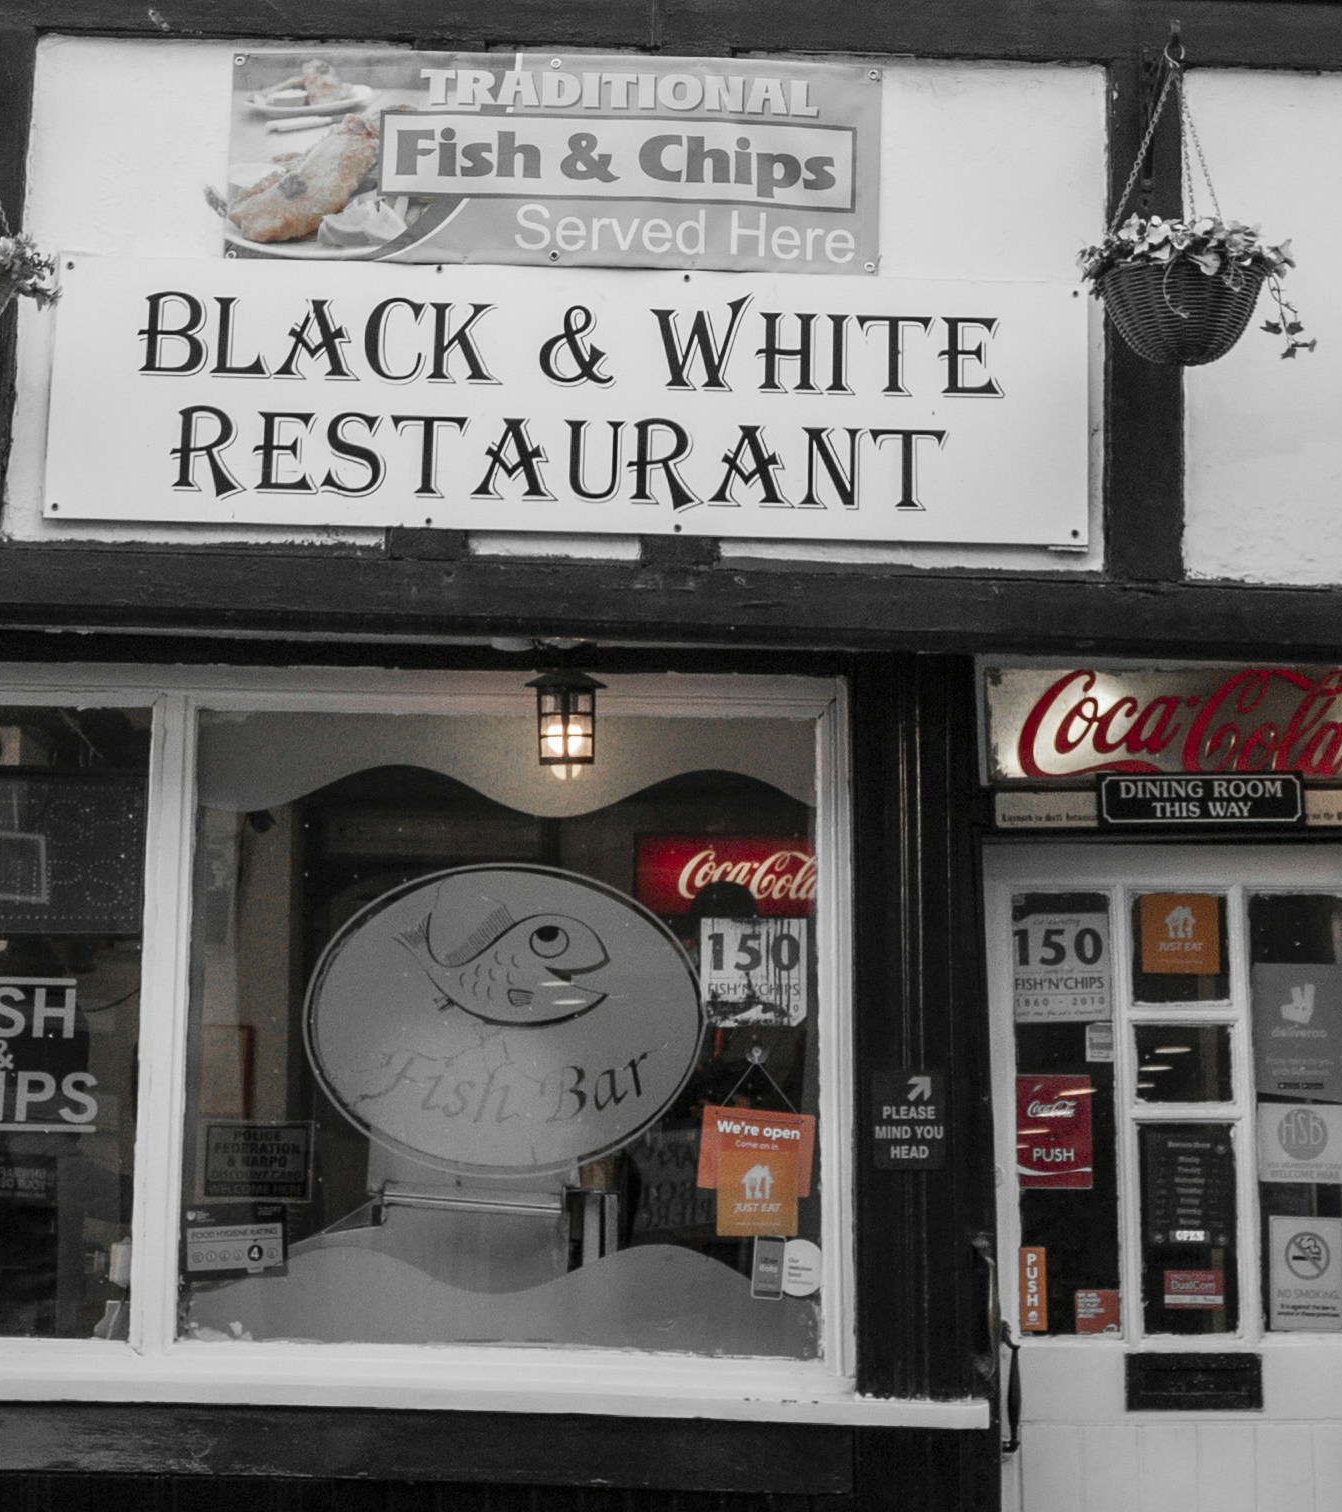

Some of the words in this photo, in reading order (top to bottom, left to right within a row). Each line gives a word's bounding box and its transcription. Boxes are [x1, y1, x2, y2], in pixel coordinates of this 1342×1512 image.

[420, 69, 820, 118] TRADITIONAL
[394, 126, 542, 180] Fish
[559, 131, 621, 183] &
[638, 134, 837, 199] Chips
[514, 203, 708, 255] Served
[730, 210, 857, 263] Here
[137, 291, 505, 386] BLACK
[538, 304, 617, 388] &
[649, 294, 1006, 398] WHITE
[170, 405, 949, 514] RESTAURANT
[1118, 780, 1204, 800] DINING
[1213, 780, 1283, 797] ROOM
[1152, 801, 1210, 818] THIS
[1213, 801, 1253, 817] WAY
[707, 932, 801, 972] 150
[1012, 927, 1104, 966] 150
[1071, 996, 1106, 1006] 2010
[359, 1048, 522, 1124] Fish
[537, 1052, 652, 1124] Bar
[882, 1106, 936, 1120] PLEASE
[1026, 1099, 1078, 1118] Coca-Cola
[233, 1130, 282, 1142] POLICE
[717, 1119, 760, 1136] We're
[762, 1126, 801, 1141] open
[874, 1125, 912, 1140] MIND
[914, 1125, 944, 1140] YOU
[1283, 1113, 1323, 1146] HSB
[213, 1142, 300, 1154] FEDERATION
[890, 1145, 930, 1159] HEAD
[1032, 1147, 1076, 1162] PUSH
[733, 1203, 760, 1214] JUST
[760, 1203, 782, 1213] EAT
[191, 1231, 215, 1240] FOOD
[216, 1229, 247, 1239] HYGIENE
[249, 1227, 278, 1237] RATING
[1175, 1230, 1205, 1242] OPEN
[250, 1246, 260, 1260] 4
[1025, 1253, 1039, 1307] PUSH
[1277, 1288, 1292, 1298] NO
